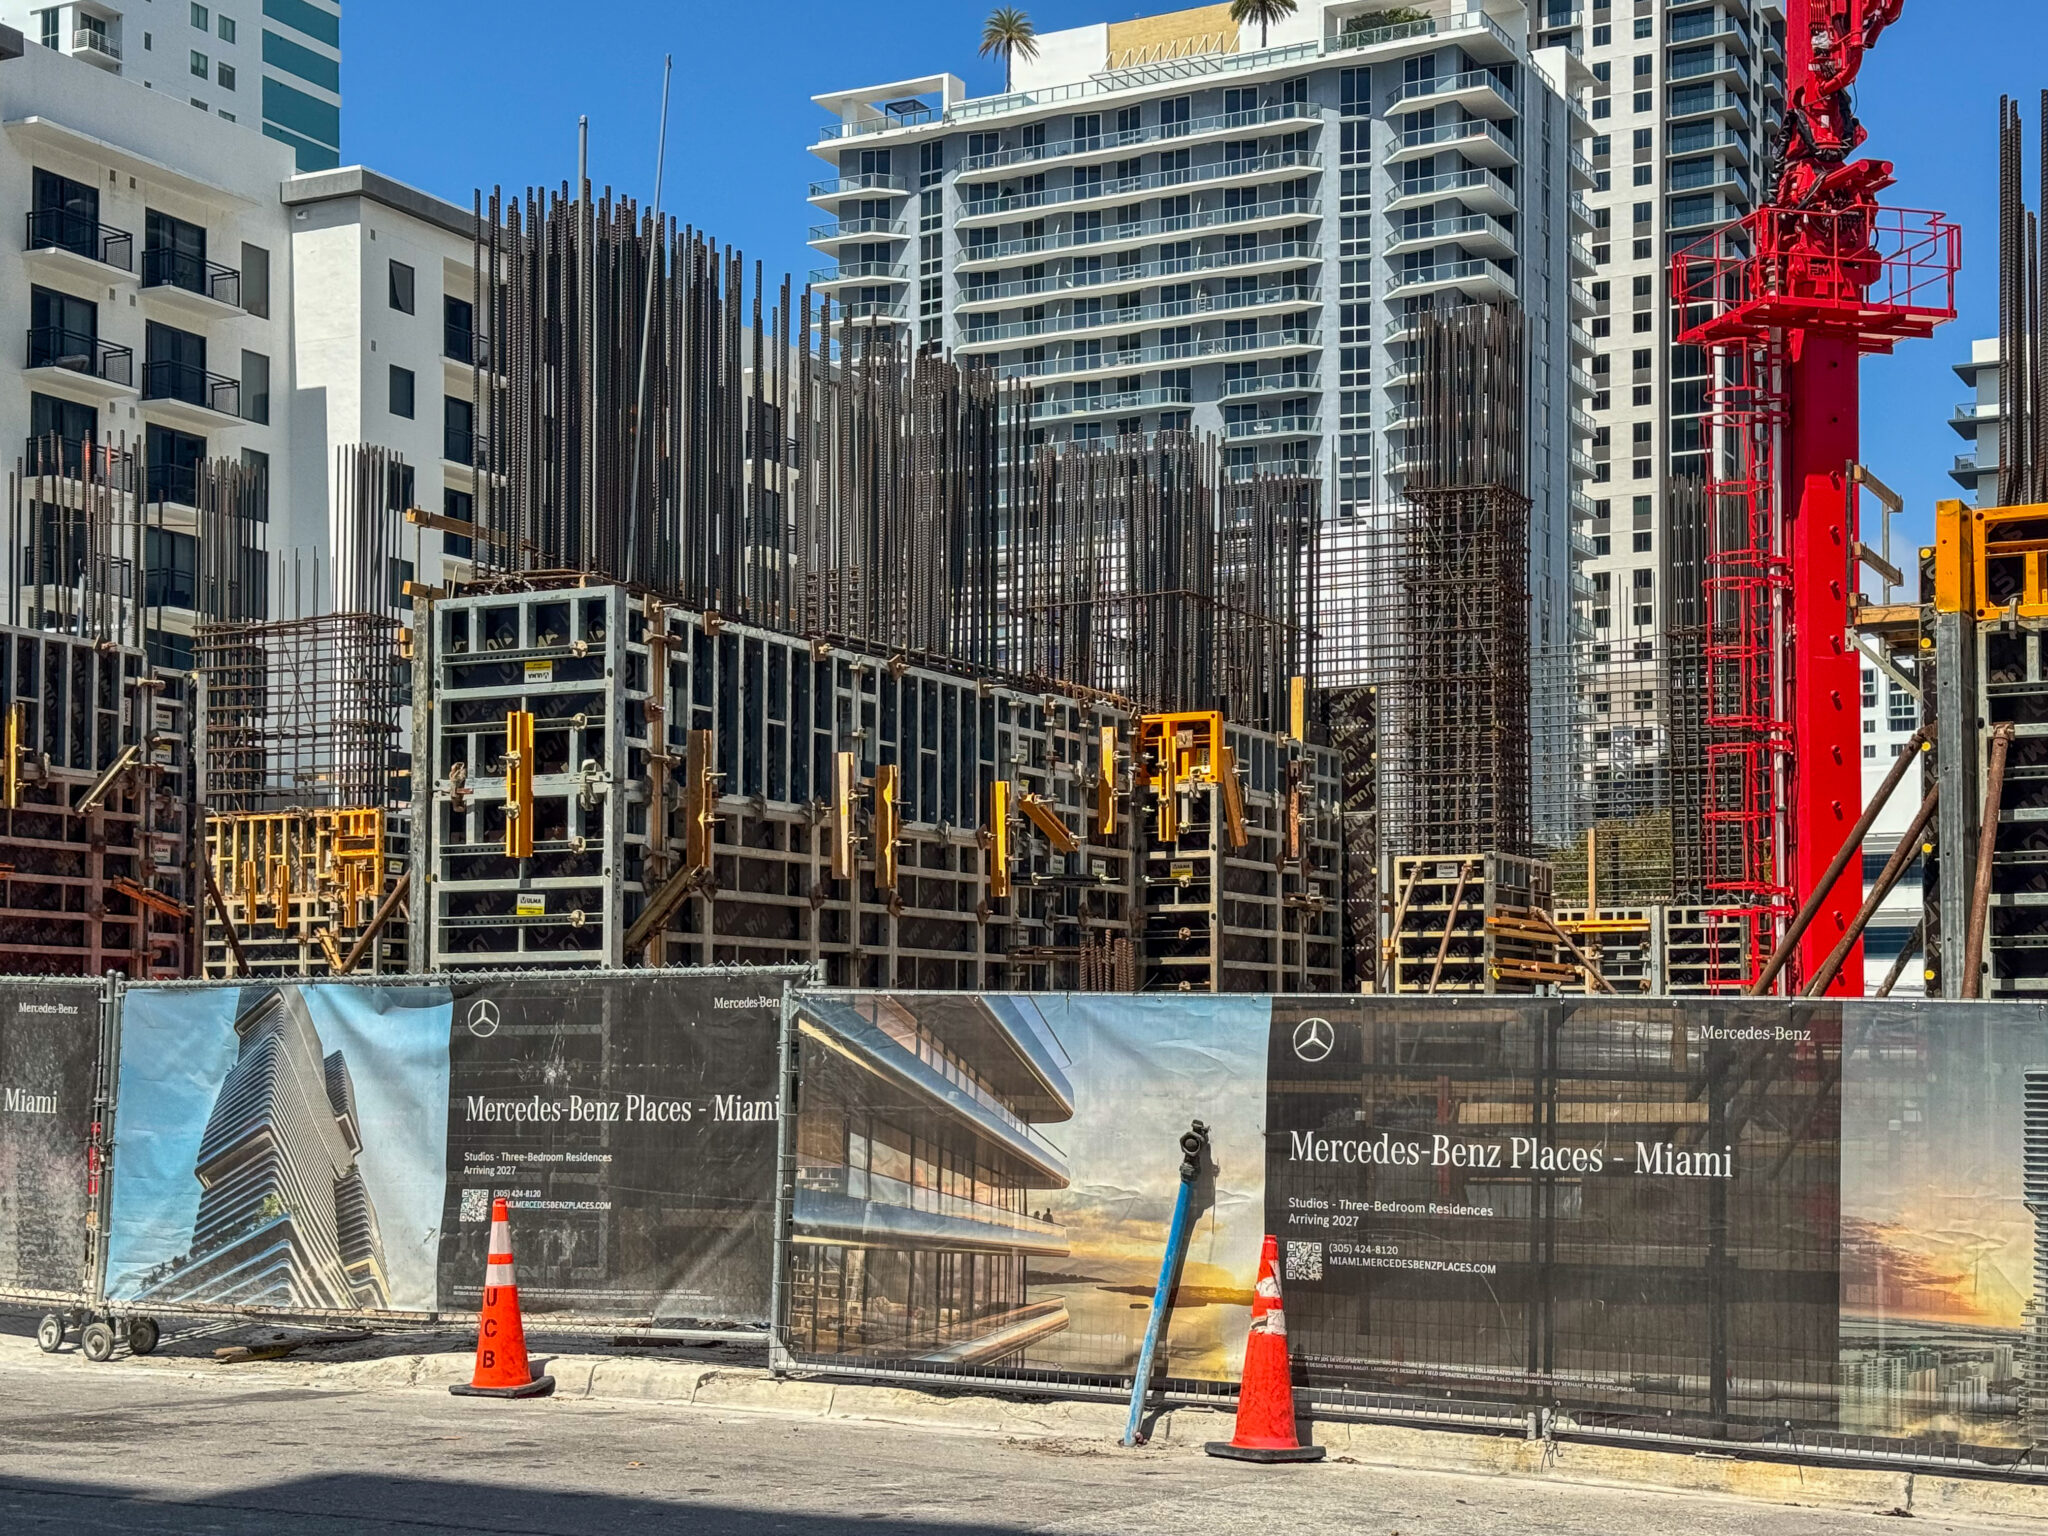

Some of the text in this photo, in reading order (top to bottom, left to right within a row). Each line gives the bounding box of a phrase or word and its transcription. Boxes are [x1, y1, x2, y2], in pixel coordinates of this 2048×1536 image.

[18, 1002, 79, 1014] Mercedes-Benz
[714, 996, 780, 1009] Mercedes-Ben
[1700, 1025, 1811, 1041] Mercedes-Benz
[3, 1088, 58, 1114] Miami
[465, 1095, 620, 1122] Mercedes-Benz
[625, 1094, 692, 1122] Places
[713, 1094, 780, 1122] Miami
[464, 1152, 494, 1162] Studios
[501, 1152, 564, 1162] Three-Bedroom
[566, 1153, 613, 1163] Residences
[1289, 1130, 1502, 1168] Mercedes-Benz
[1510, 1137, 1603, 1173] Places
[1634, 1141, 1733, 1178] Miami
[464, 1165, 516, 1177] Arriving 2027
[511, 1190, 542, 1198] 424-8120
[505, 1200, 612, 1210] MI.MERCEDESBENZPLACES.COM
[1288, 1197, 1329, 1210] Studios
[1339, 1199, 1426, 1214] Three-Bedroom
[1429, 1202, 1494, 1217] Residences
[1288, 1213, 1359, 1228] Arriving 2027
[1329, 1243, 1399, 1255] (305) 424-8120
[1329, 1256, 1496, 1274] MIAMI.MERCEDESBENZPLACES.COM
[1524, 1378, 1552, 1386] MARKETING
